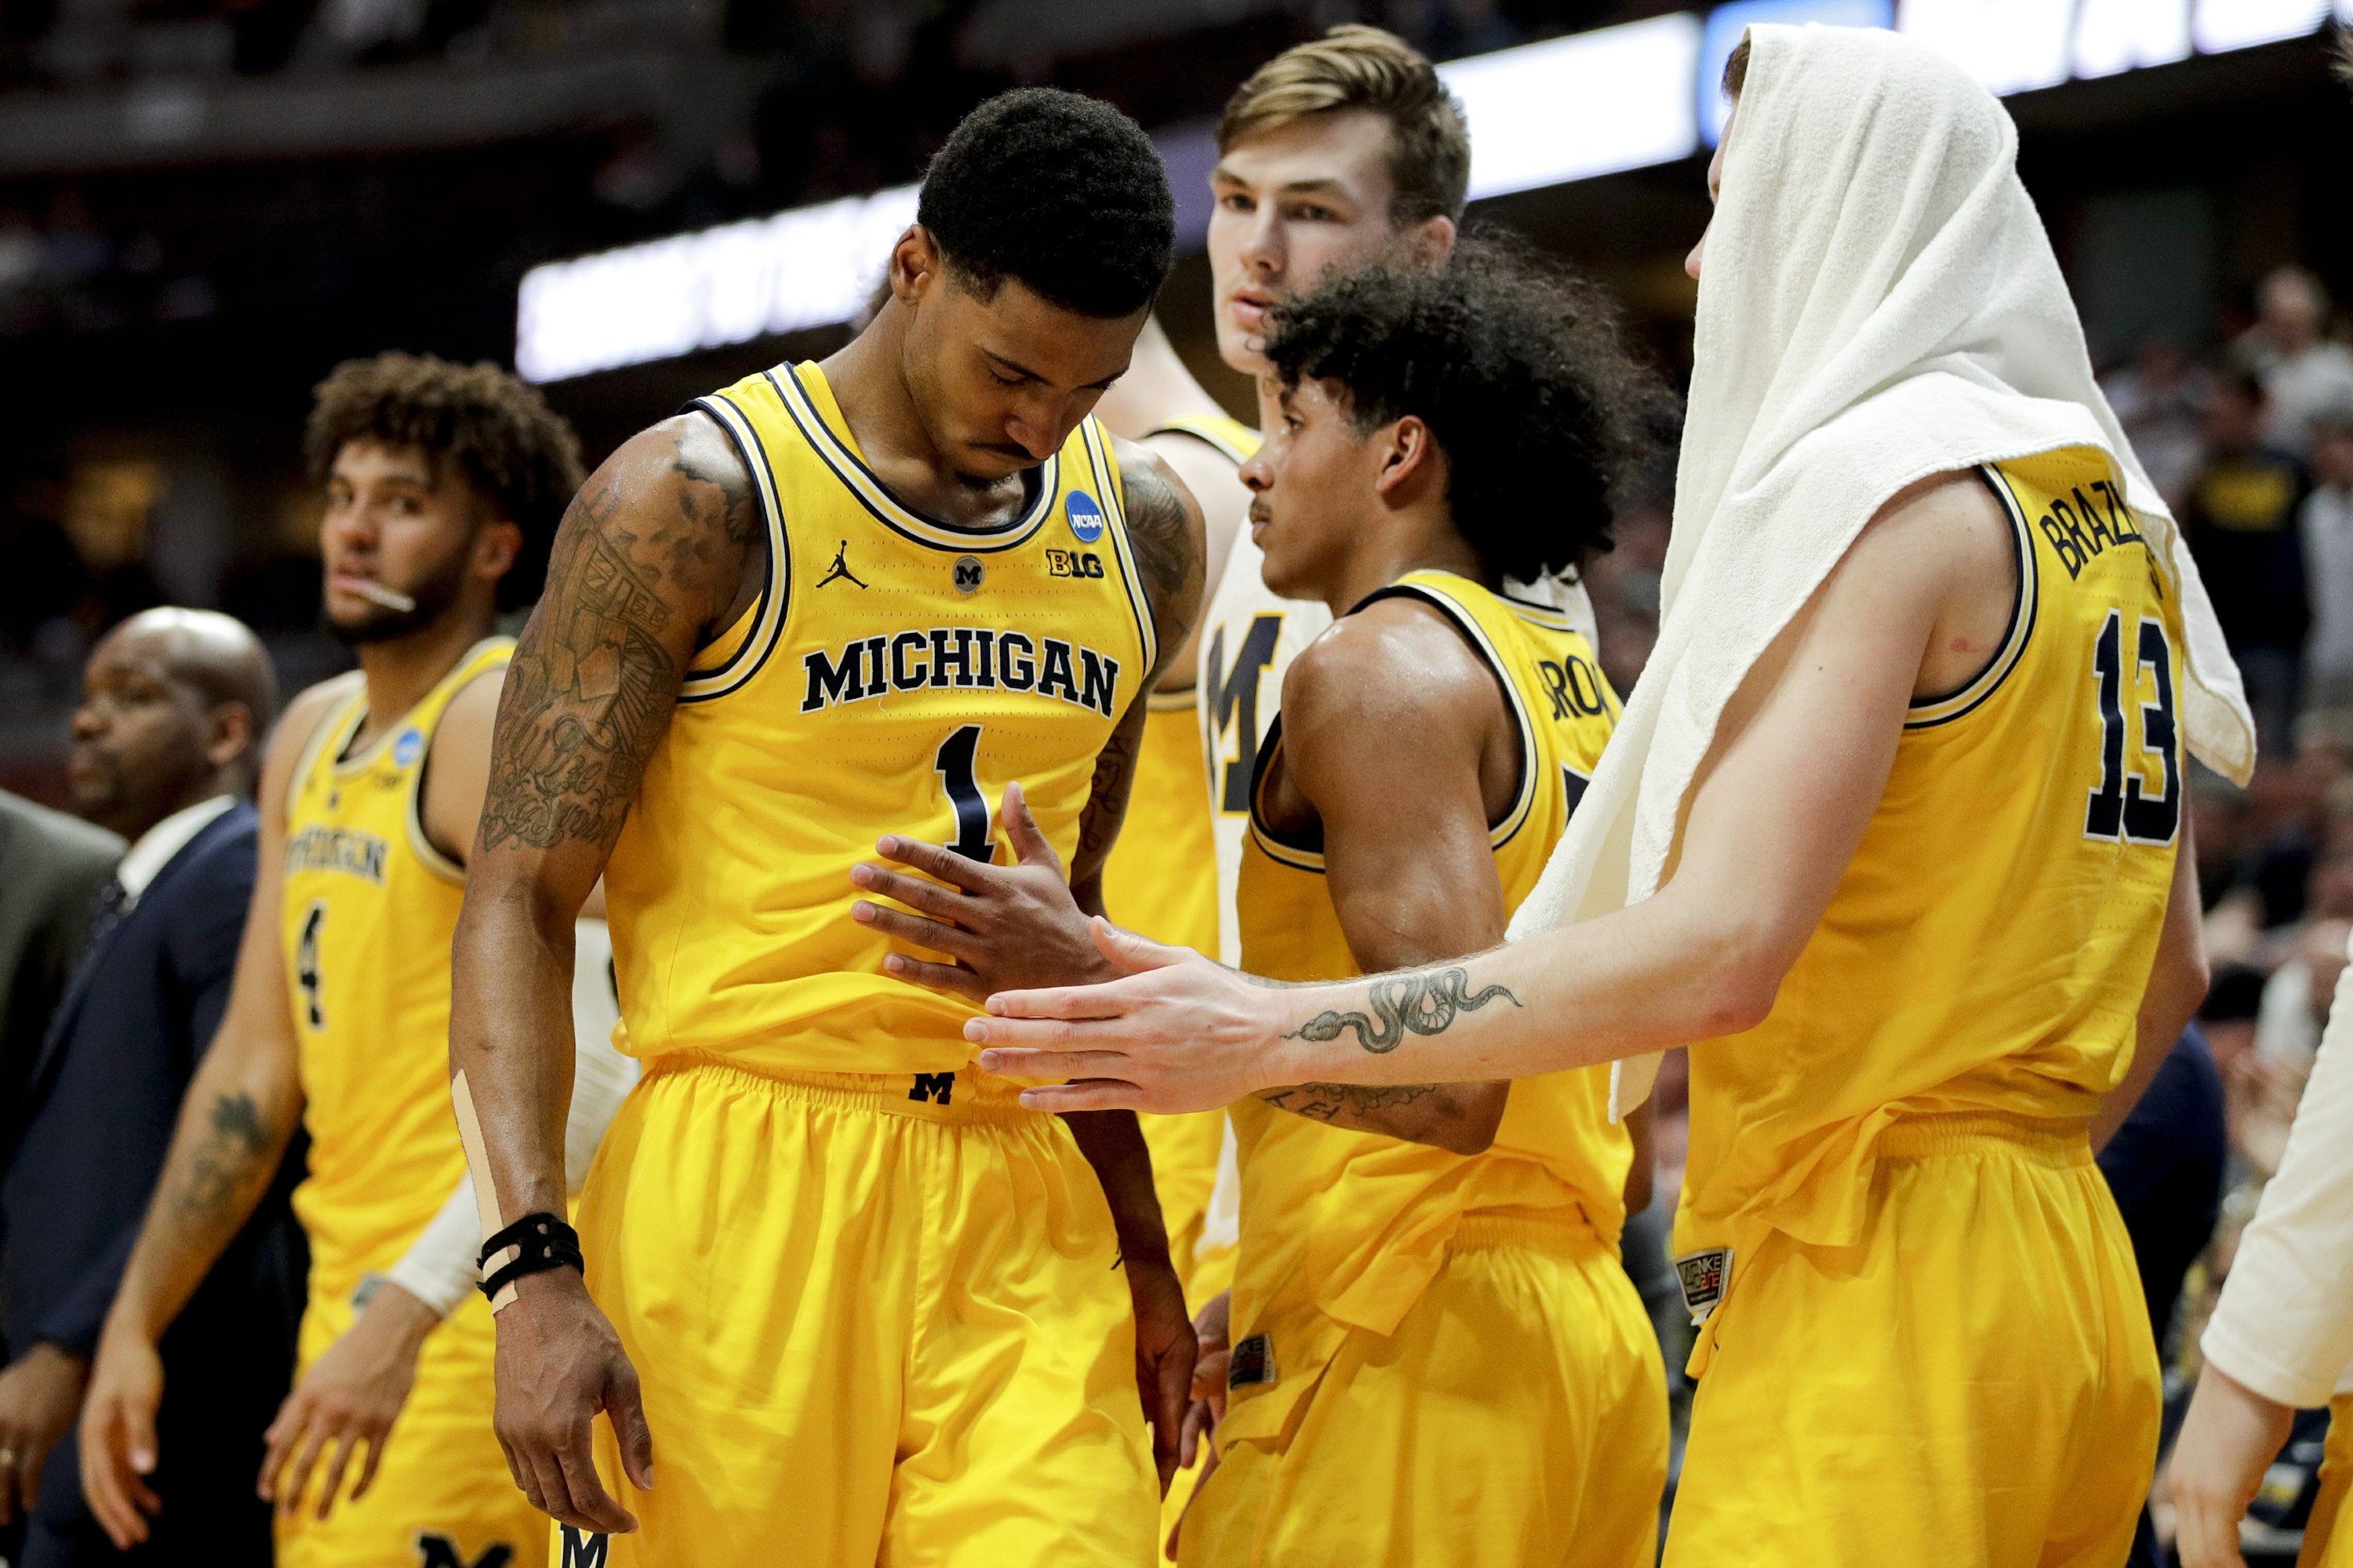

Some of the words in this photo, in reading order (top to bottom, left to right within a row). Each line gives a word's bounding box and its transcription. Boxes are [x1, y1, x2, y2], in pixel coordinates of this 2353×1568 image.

[1072, 514, 1103, 529] NCAA
[955, 565, 982, 584] M
[799, 626, 1120, 720] MICHIGAN
[2083, 608, 2183, 847] 13
[933, 722, 998, 863] 1
[296, 899, 329, 1033] 4
[907, 1071, 956, 1106] M
[558, 1521, 613, 1568] M
